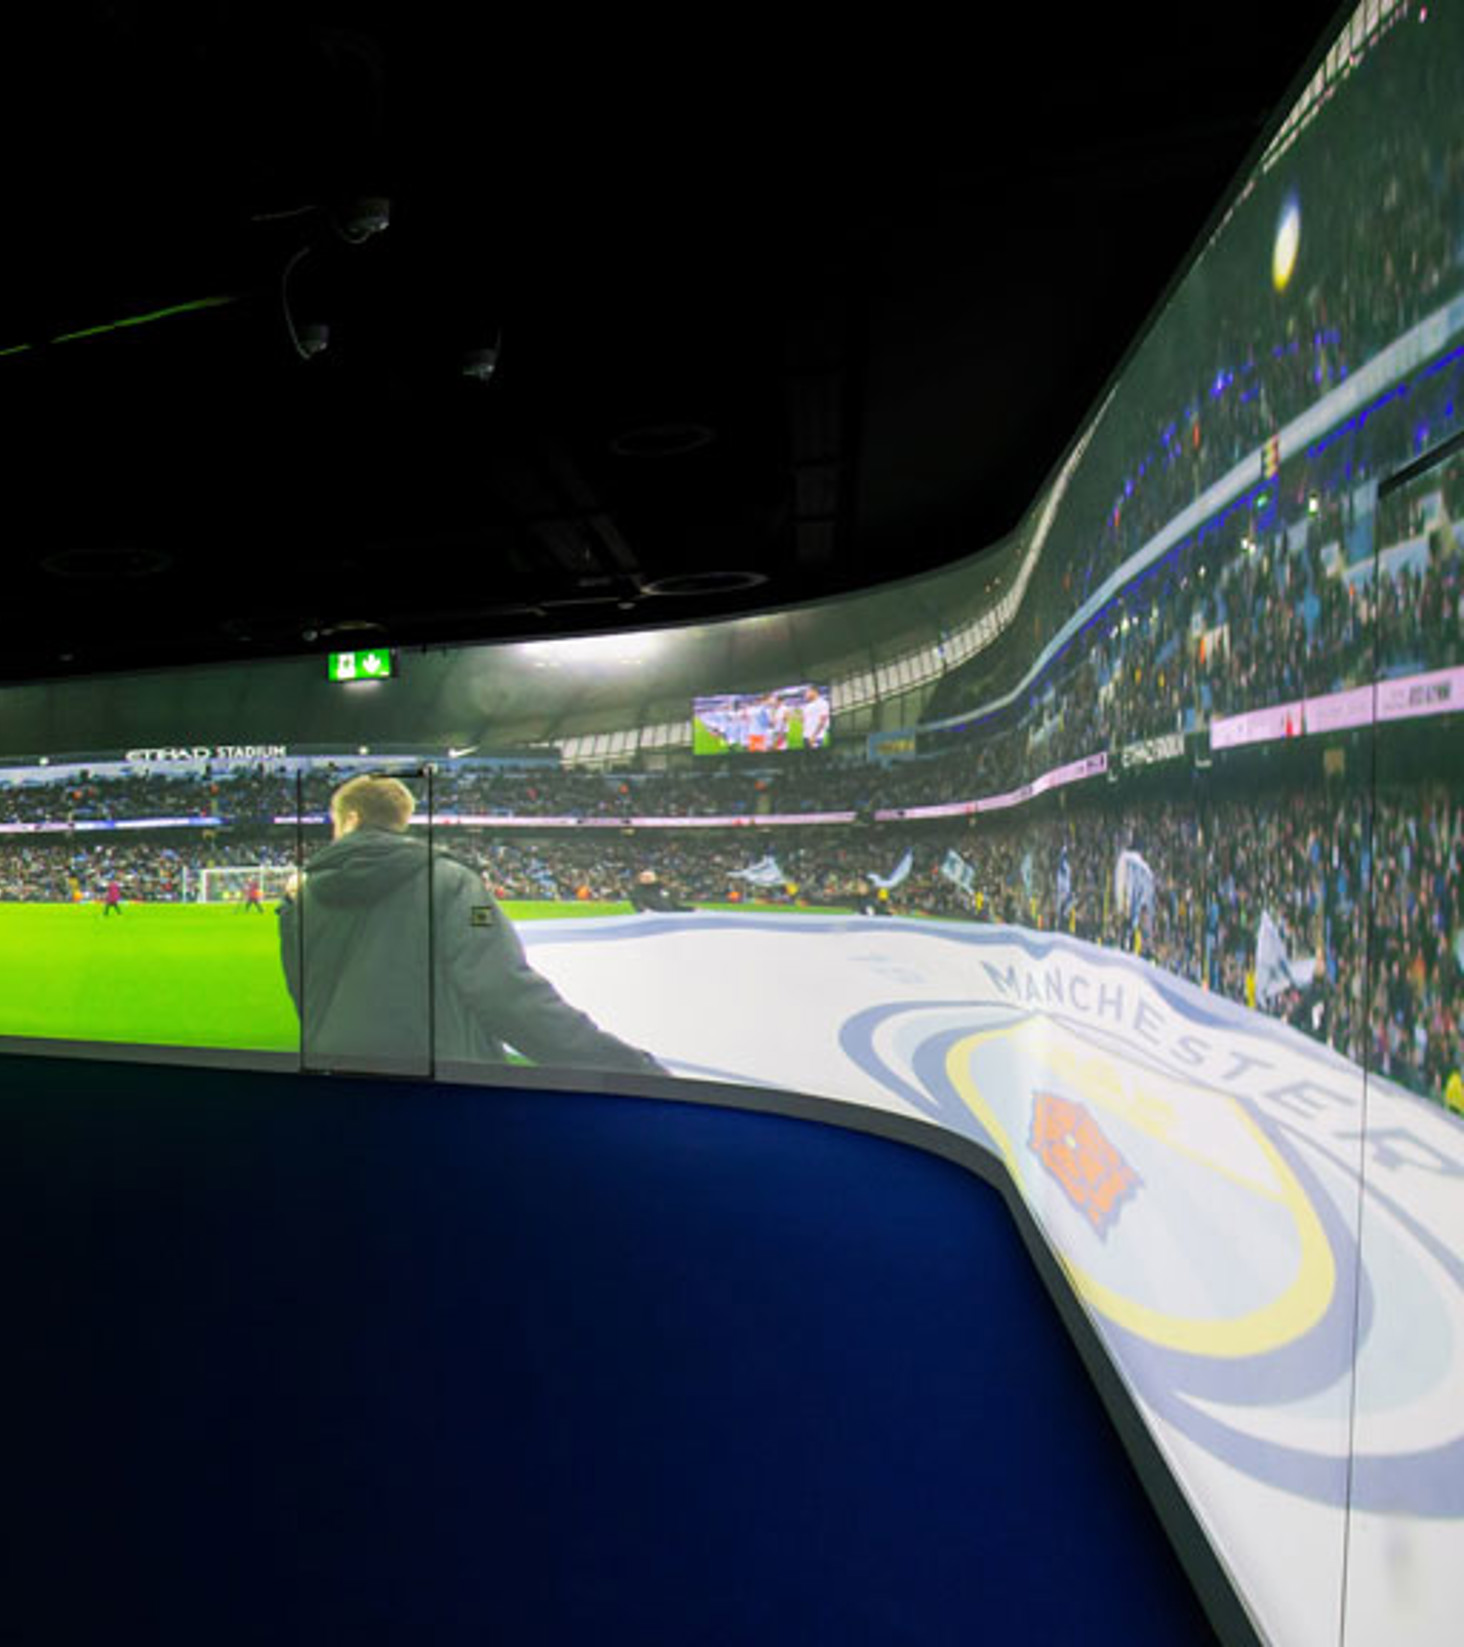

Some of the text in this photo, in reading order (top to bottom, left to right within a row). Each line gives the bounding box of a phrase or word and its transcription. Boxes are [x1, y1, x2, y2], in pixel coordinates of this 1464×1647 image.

[126, 745, 286, 763] ETIHAD STADIUM
[980, 958, 1464, 1179] MANCHESTER
